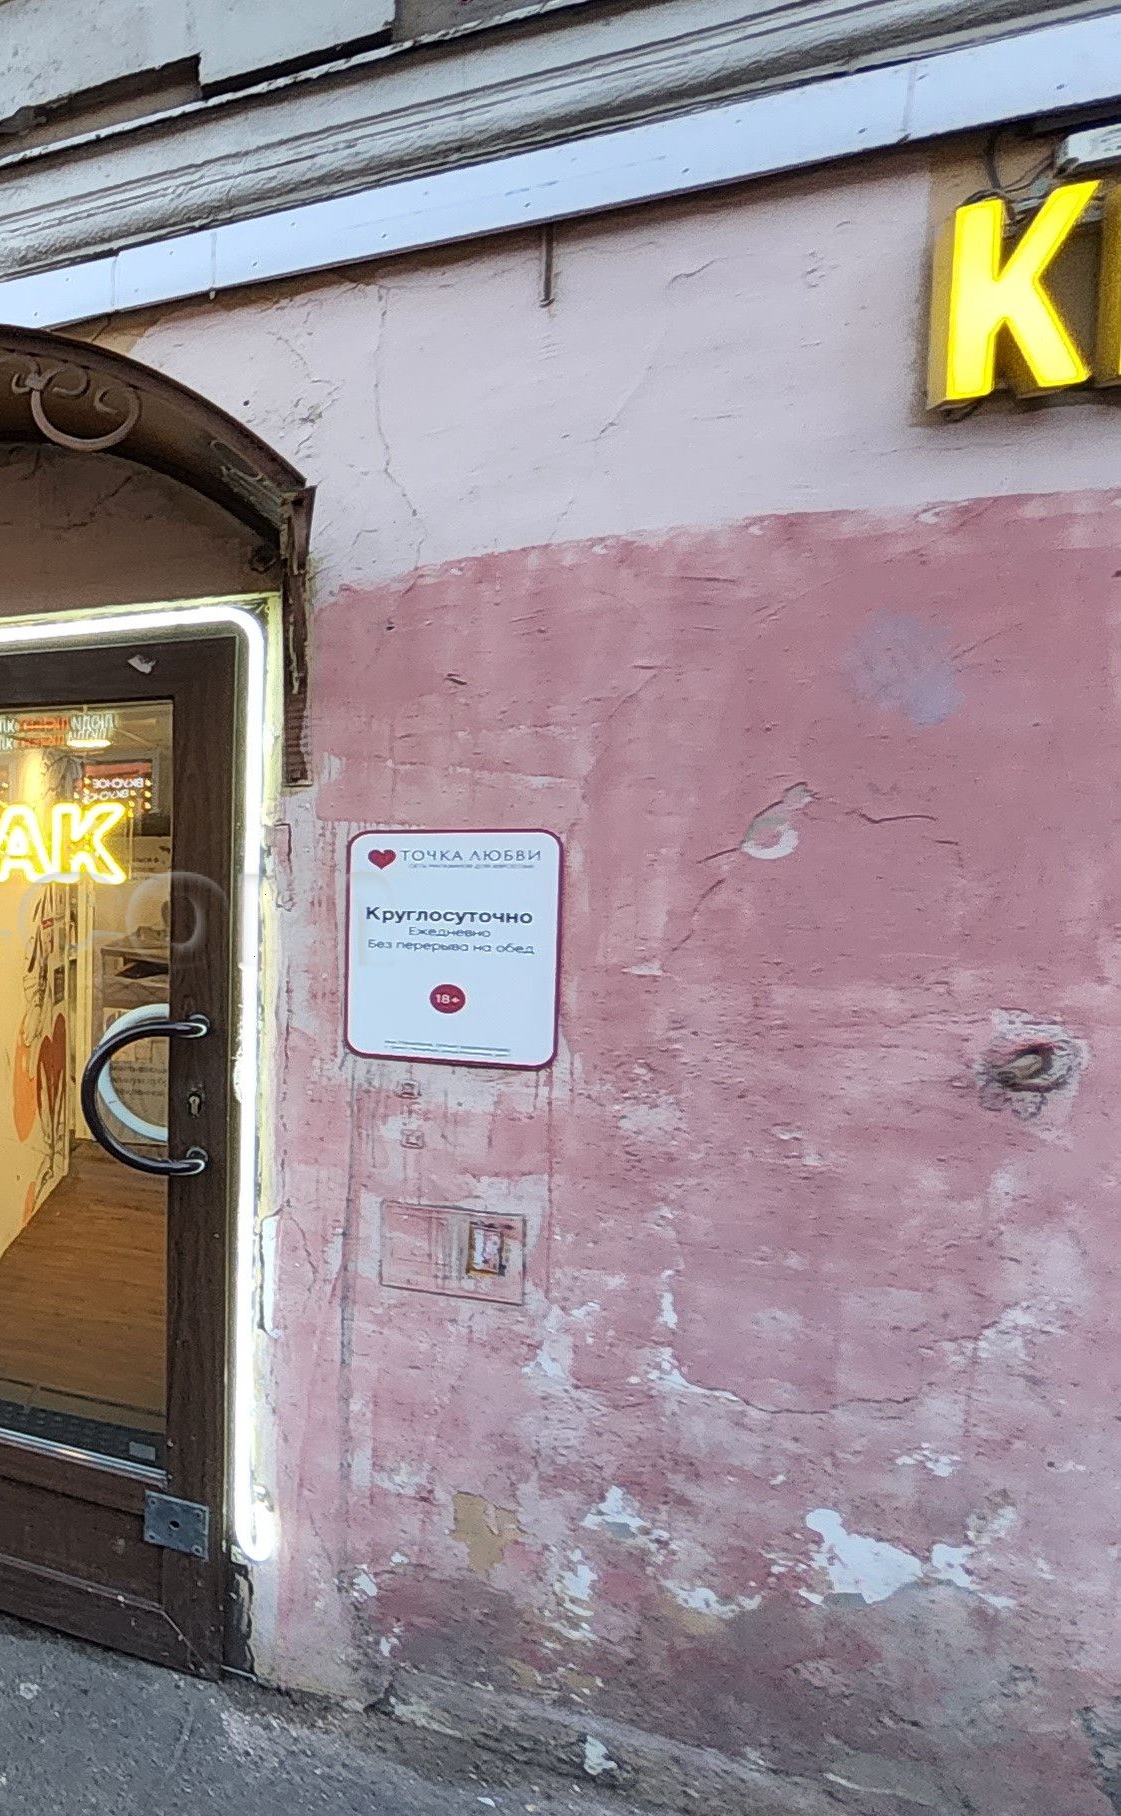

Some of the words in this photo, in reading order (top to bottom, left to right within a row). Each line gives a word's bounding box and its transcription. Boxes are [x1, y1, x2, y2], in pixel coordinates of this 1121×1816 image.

[946, 180, 1121, 399] К
[401, 849, 461, 862] ТОЧКА
[469, 849, 541, 862] ЛЮБВИ
[366, 906, 533, 925] Круглосуточно
[409, 926, 491, 938] Ежедневно
[368, 939, 392, 950] Без
[396, 941, 469, 953] перерыва
[473, 944, 492, 953] на
[496, 943, 535, 955] обед
[435, 993, 461, 1004] 18+
